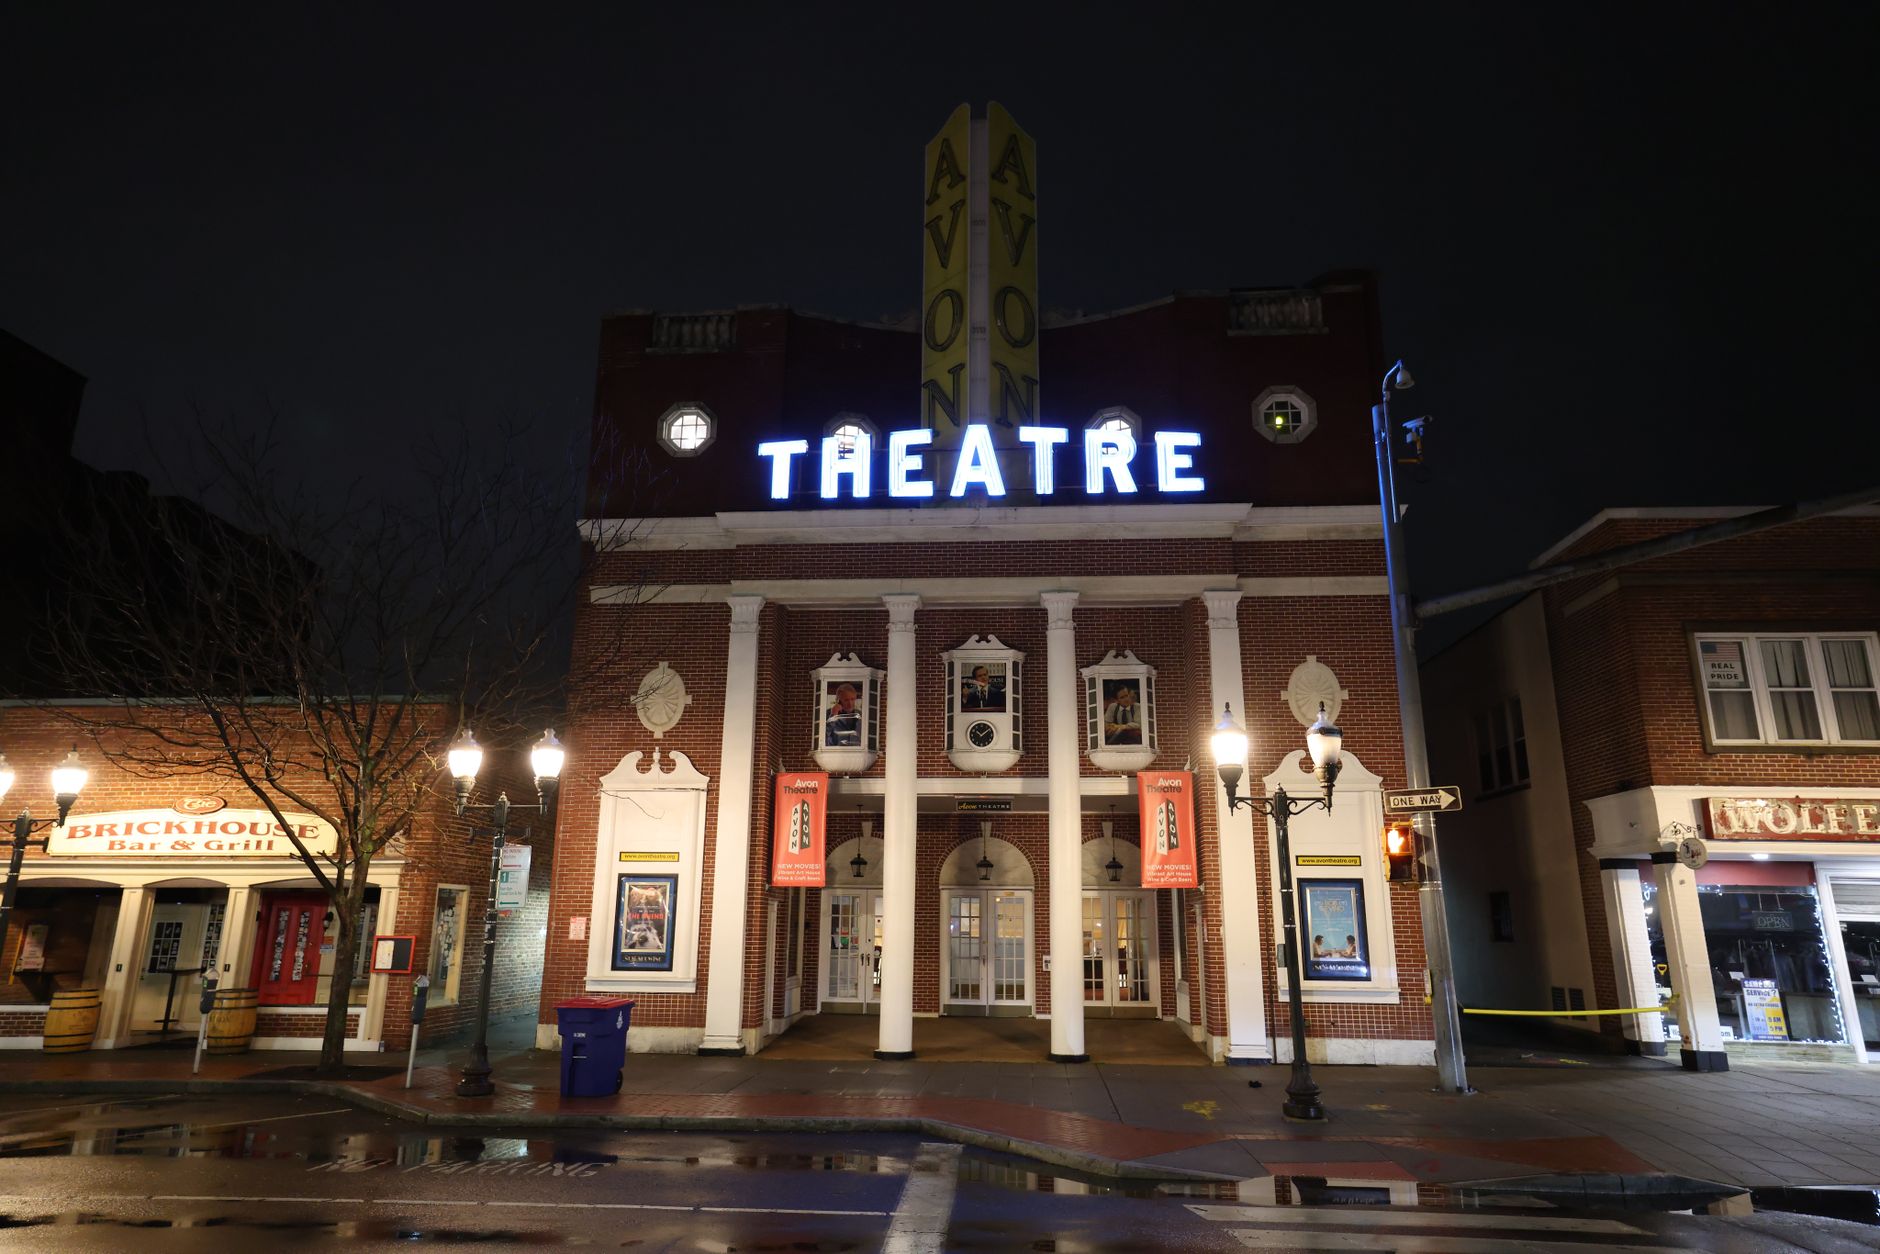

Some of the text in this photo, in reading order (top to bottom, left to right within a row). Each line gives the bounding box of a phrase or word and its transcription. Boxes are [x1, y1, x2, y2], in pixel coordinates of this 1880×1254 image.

[991, 133, 1039, 428] AVON
[921, 137, 966, 437] AVON
[758, 424, 1205, 499] THEATRE
[1710, 662, 1735, 670] REAL
[795, 779, 818, 787] Avon
[1158, 777, 1182, 786] Avon
[783, 786, 818, 794] Theatre
[1146, 784, 1182, 793] Theatre
[1392, 794, 1442, 806] ONE WAY
[1168, 802, 1177, 846] AVON
[66, 821, 321, 840] BRICKHOUSE
[107, 839, 275, 851] Bar & Grill
